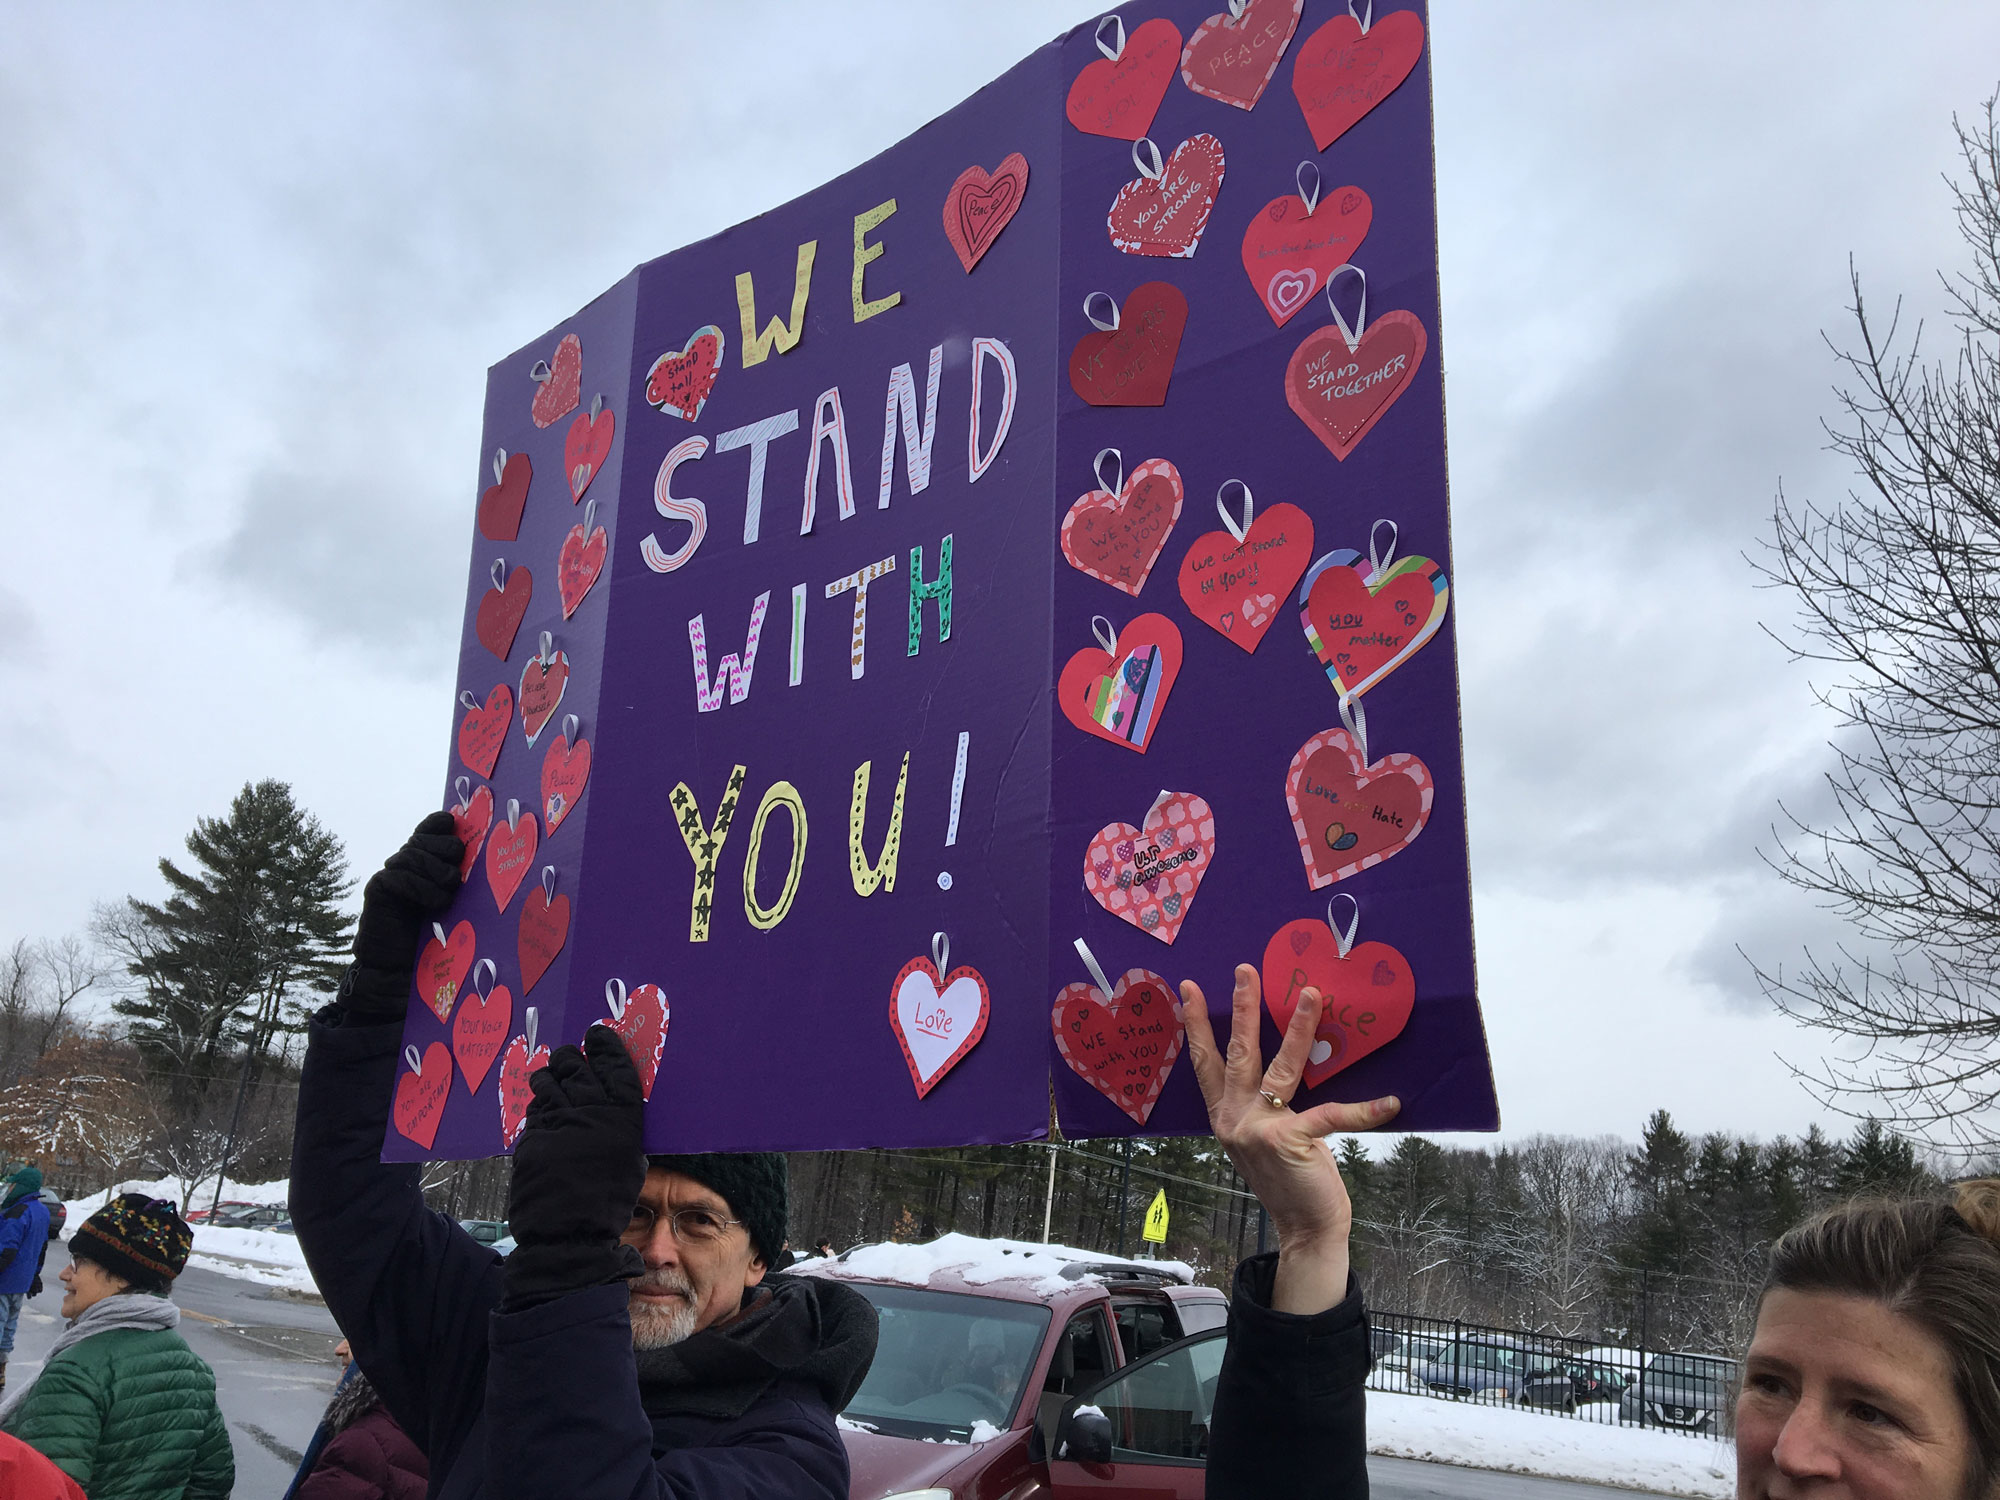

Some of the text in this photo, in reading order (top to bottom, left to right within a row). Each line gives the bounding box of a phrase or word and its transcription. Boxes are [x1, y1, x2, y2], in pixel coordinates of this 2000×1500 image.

[1209, 20, 1281, 76] PEACE
[1133, 169, 1189, 229] YOU ARE
[1152, 181, 1202, 235] STRONG
[735, 198, 902, 369] WE
[1305, 349, 1331, 374] WE
[1307, 363, 1360, 390] STAND
[1320, 354, 1406, 401] TOGETHER
[670, 370, 693, 393] tall
[640, 337, 1018, 573] STAND
[1131, 518, 1160, 543] YOU
[688, 533, 953, 713] WITH
[1347, 632, 1404, 648] matter
[1304, 776, 1341, 805] Love
[1371, 804, 1404, 830] Hate
[496, 833, 527, 862] YOU ARE
[497, 851, 526, 876] STRONG
[914, 1001, 953, 1034] Love
[1283, 967, 1377, 1037] Pace
[1080, 1032, 1107, 1051] WE
[1094, 1042, 1159, 1072] with YOU
